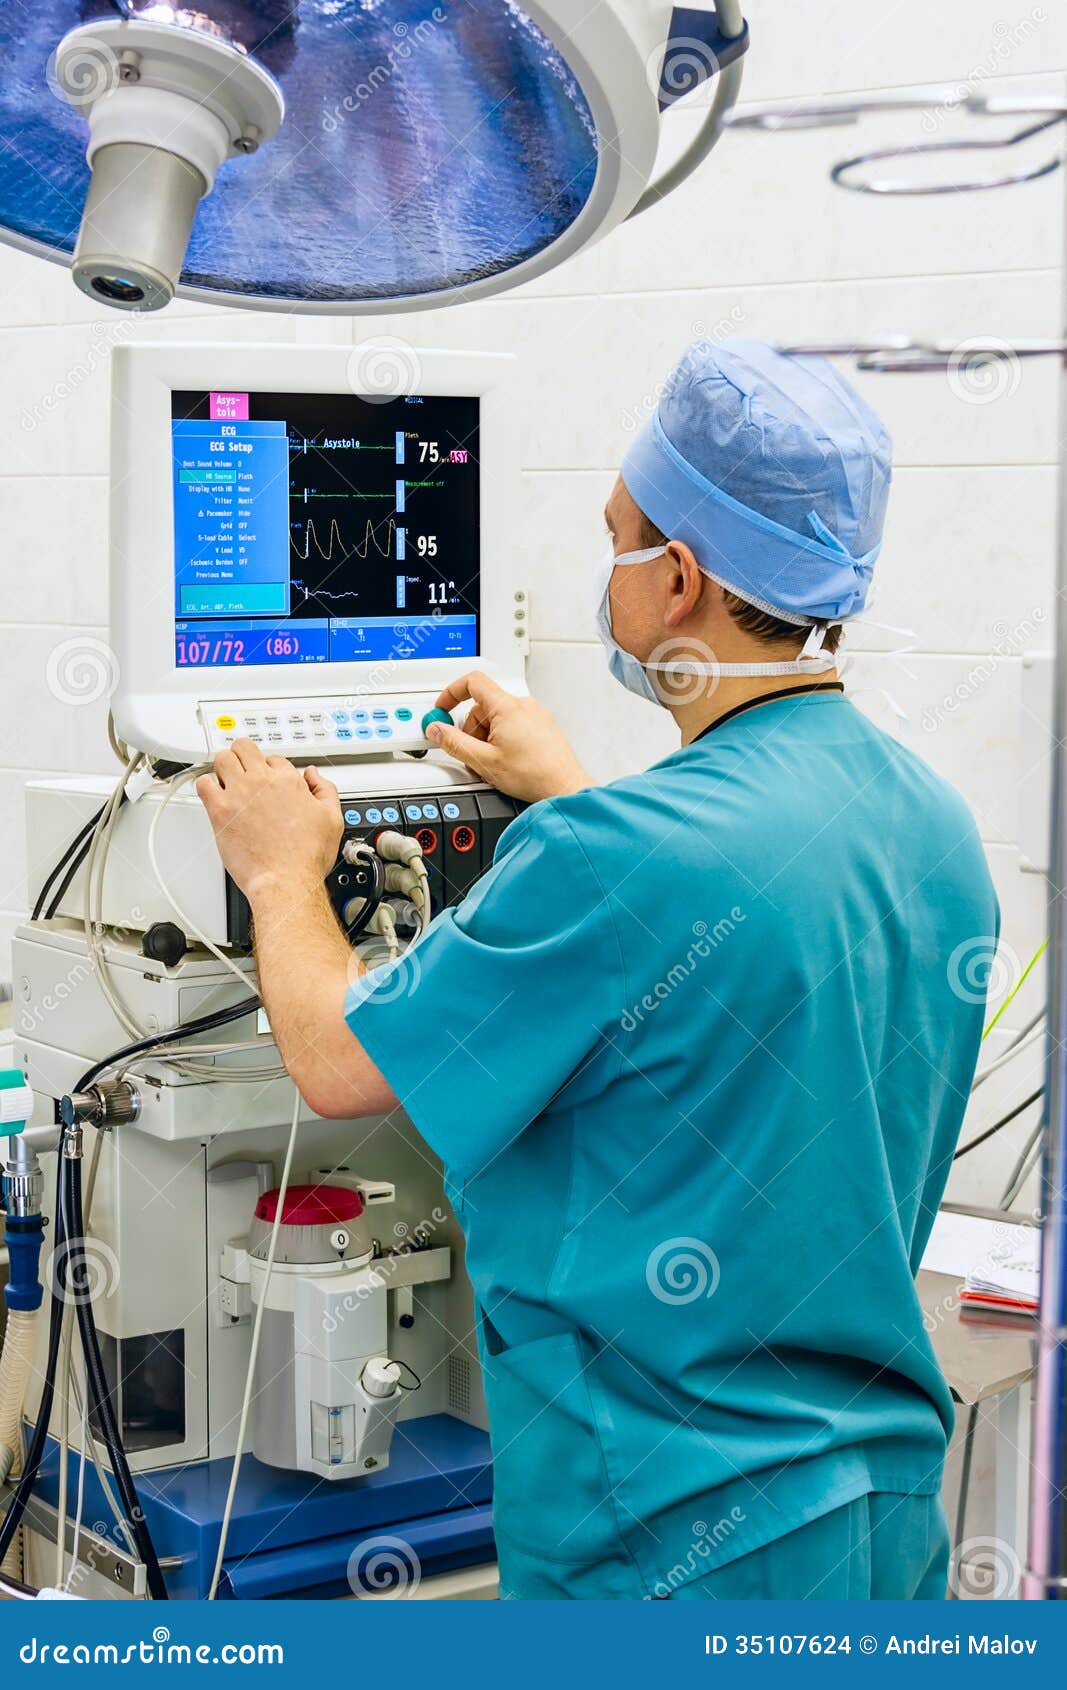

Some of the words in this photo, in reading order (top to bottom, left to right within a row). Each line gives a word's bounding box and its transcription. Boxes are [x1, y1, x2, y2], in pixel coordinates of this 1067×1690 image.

[216, 395, 240, 407] Asys-
[216, 407, 236, 417] tole
[221, 426, 236, 436] ECG
[210, 442, 225, 452] ECG
[229, 442, 253, 453] Setup
[323, 438, 360, 450] Asystole
[418, 441, 439, 463] 75
[450, 450, 468, 464] ASY
[188, 485, 210, 494] Display
[206, 510, 232, 518] Pacemaker
[220, 522, 233, 530] Grid
[217, 534, 233, 542] Cable
[417, 535, 438, 557] 95
[190, 559, 214, 567] Ischemic
[196, 571, 220, 579] Previous
[428, 583, 448, 604] 11
[177, 640, 245, 664] 107/72
[266, 637, 299, 656] (86)
